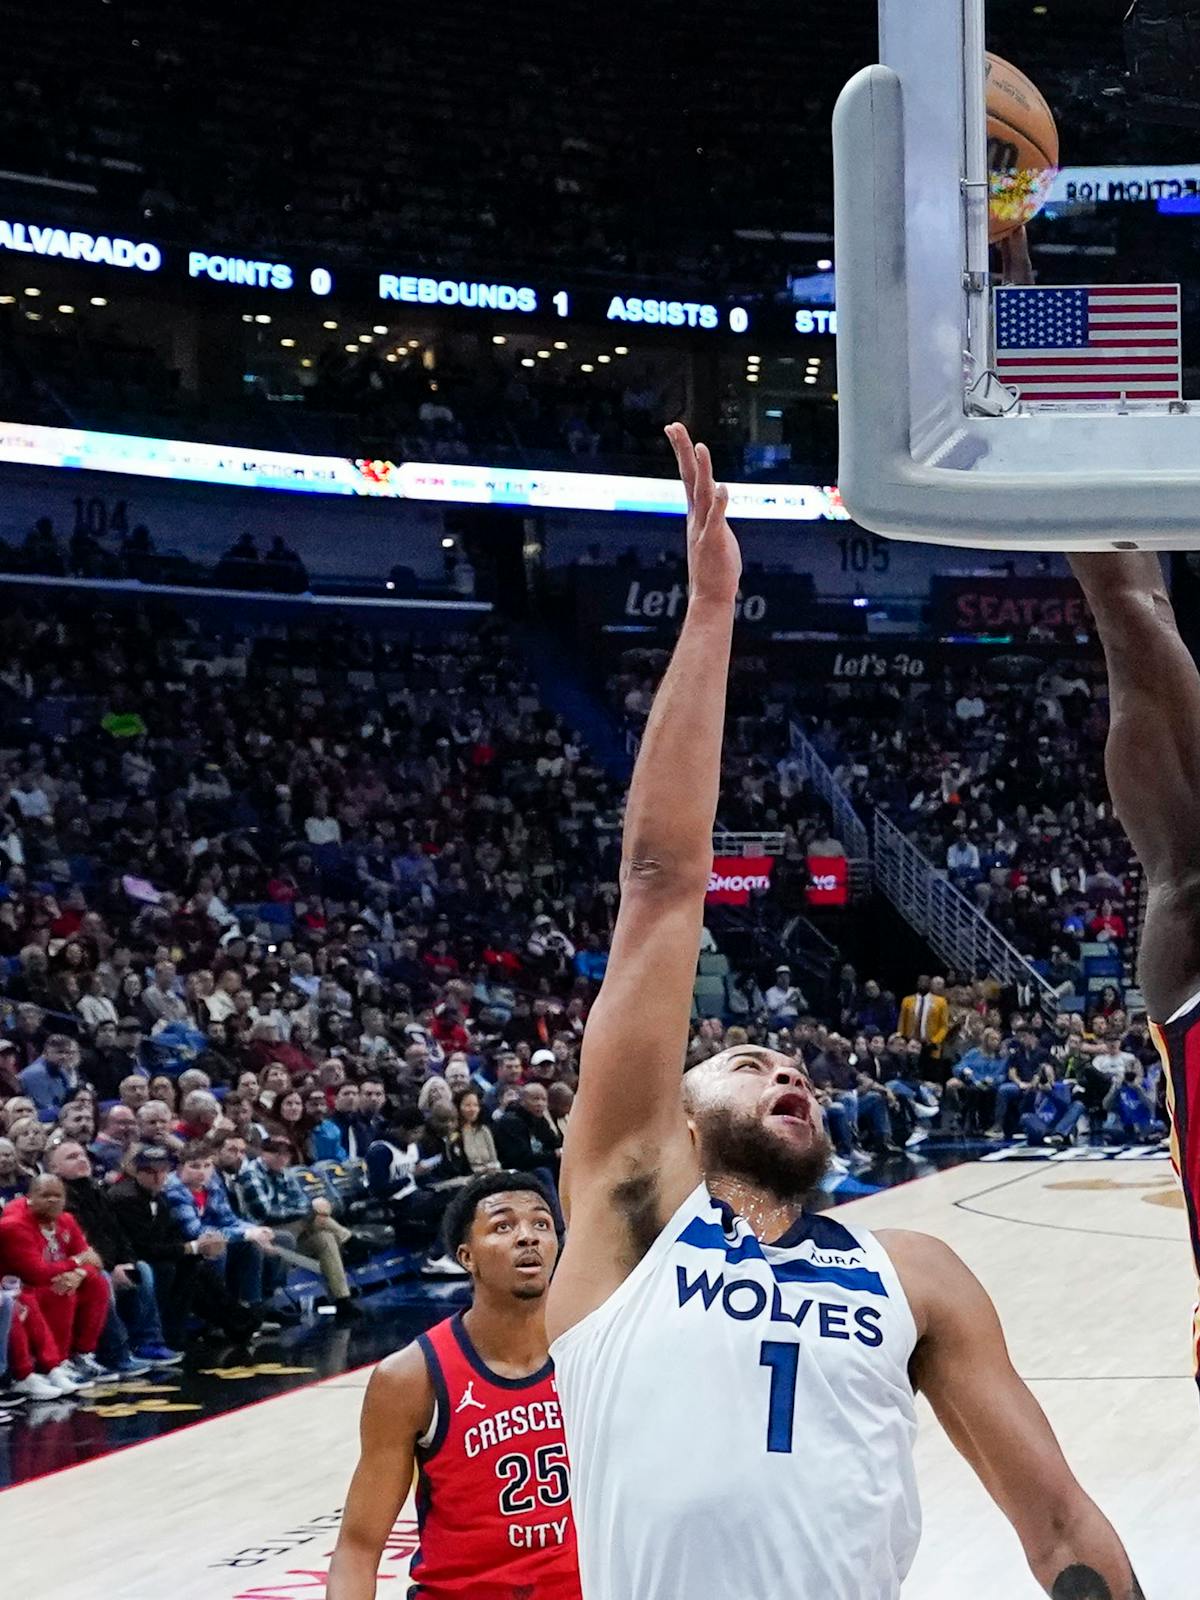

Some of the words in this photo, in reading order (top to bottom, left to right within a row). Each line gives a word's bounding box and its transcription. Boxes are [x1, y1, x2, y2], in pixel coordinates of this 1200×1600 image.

[188, 251, 293, 289] POINTS
[310, 268, 332, 295] 0
[379, 274, 537, 313] REBOUNDS
[552, 291, 568, 317] 1
[606, 296, 718, 329] ASSISTS
[729, 307, 748, 333] 0
[837, 537, 890, 573] 105
[676, 1265, 884, 1348] WOLVES
[464, 1401, 565, 1458] CRESCE
[759, 1340, 801, 1454] 1
[495, 1442, 571, 1516] 25
[508, 1516, 569, 1548] CITY
